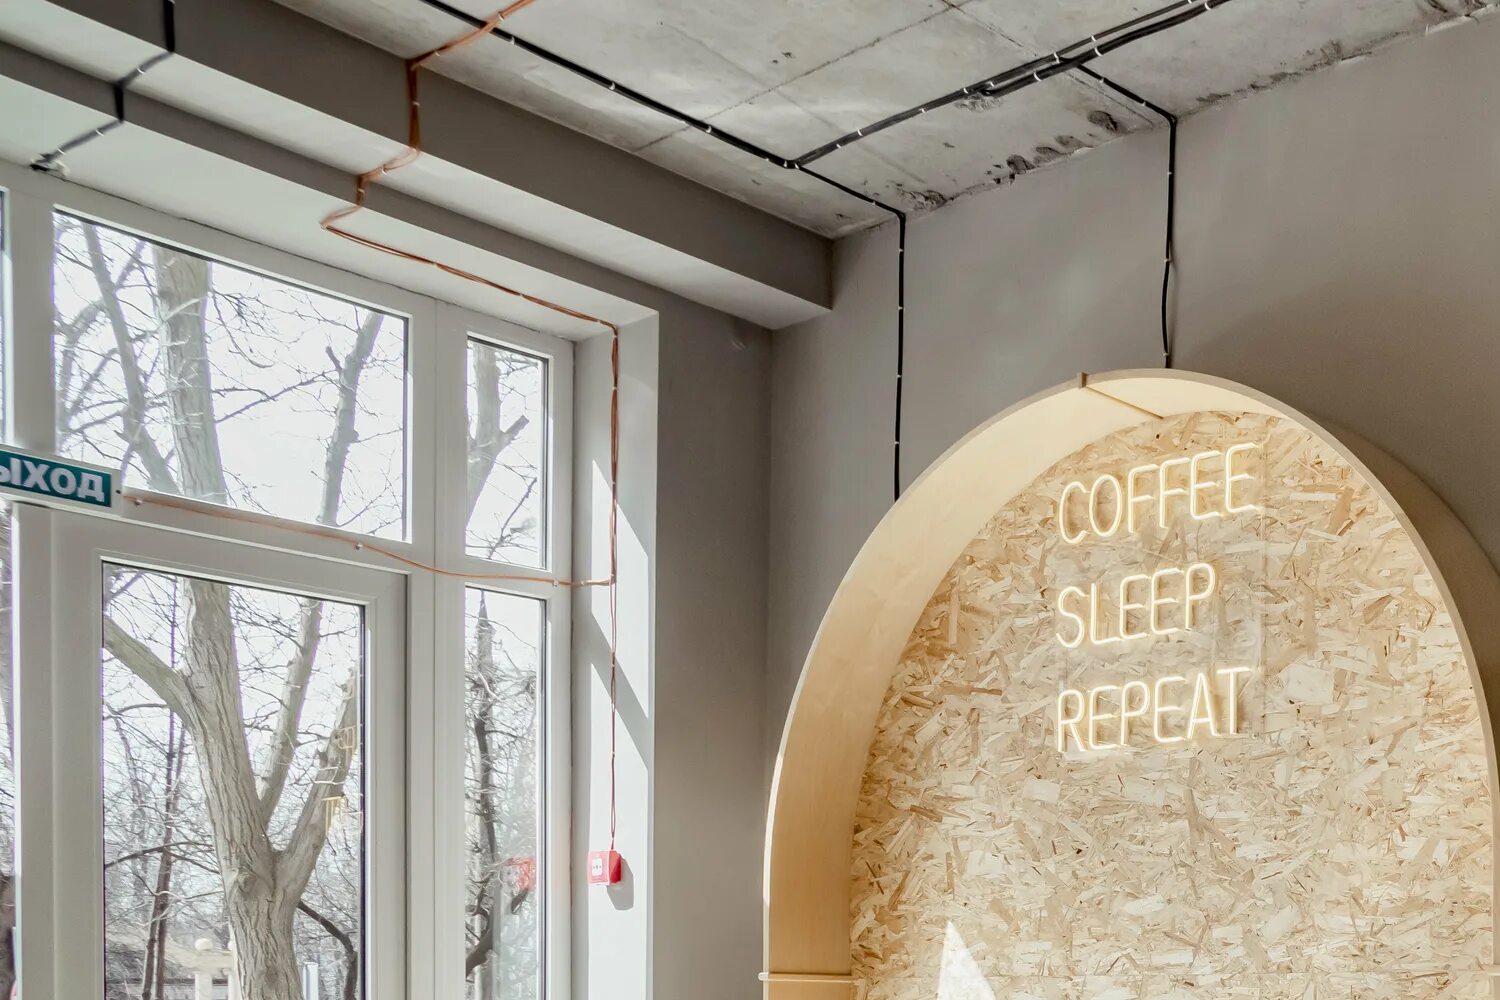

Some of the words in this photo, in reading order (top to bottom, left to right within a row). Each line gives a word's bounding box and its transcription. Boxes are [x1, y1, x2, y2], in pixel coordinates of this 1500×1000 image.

[1059, 442, 1261, 545] COFFEE
[1056, 562, 1216, 648] SLEEP
[1057, 666, 1253, 752] REPEAT
